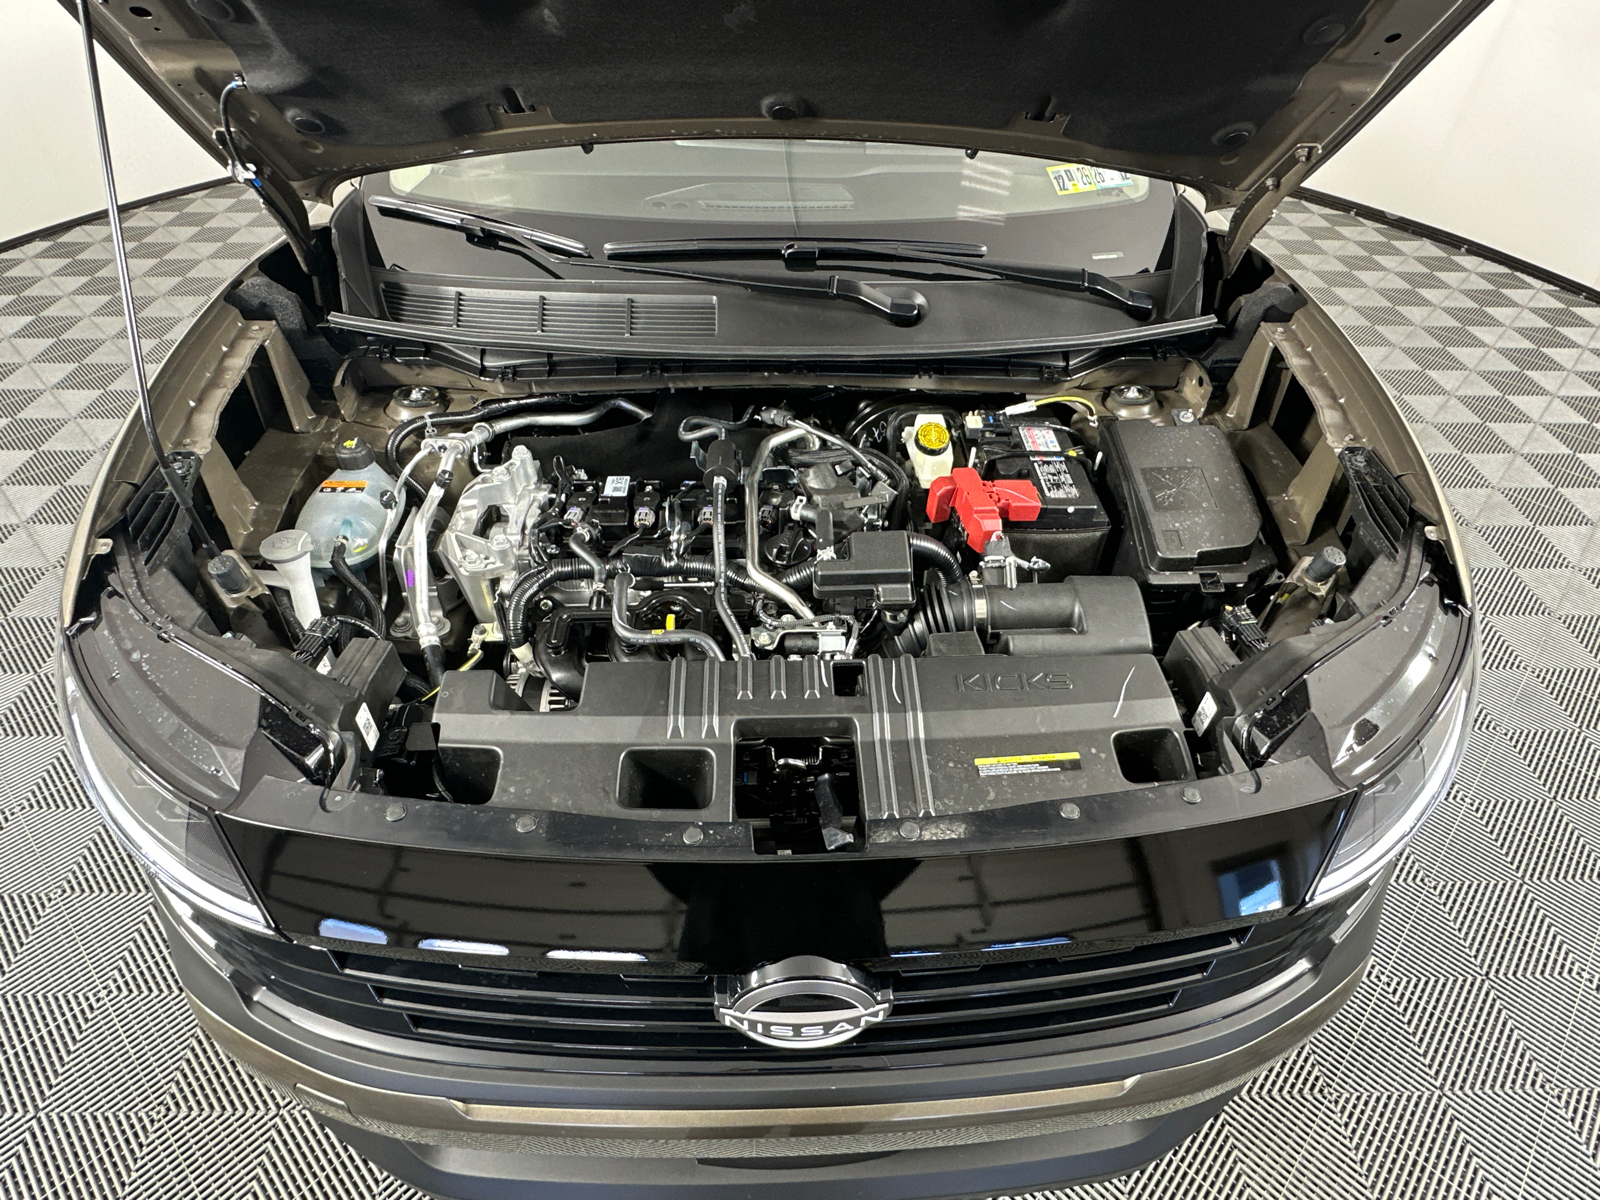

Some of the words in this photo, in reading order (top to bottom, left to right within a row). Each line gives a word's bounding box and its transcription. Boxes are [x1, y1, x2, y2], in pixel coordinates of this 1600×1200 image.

[1053, 174, 1069, 191] 12
[955, 672, 1075, 692] KICKS
[724, 1010, 884, 1037] NISSAN
